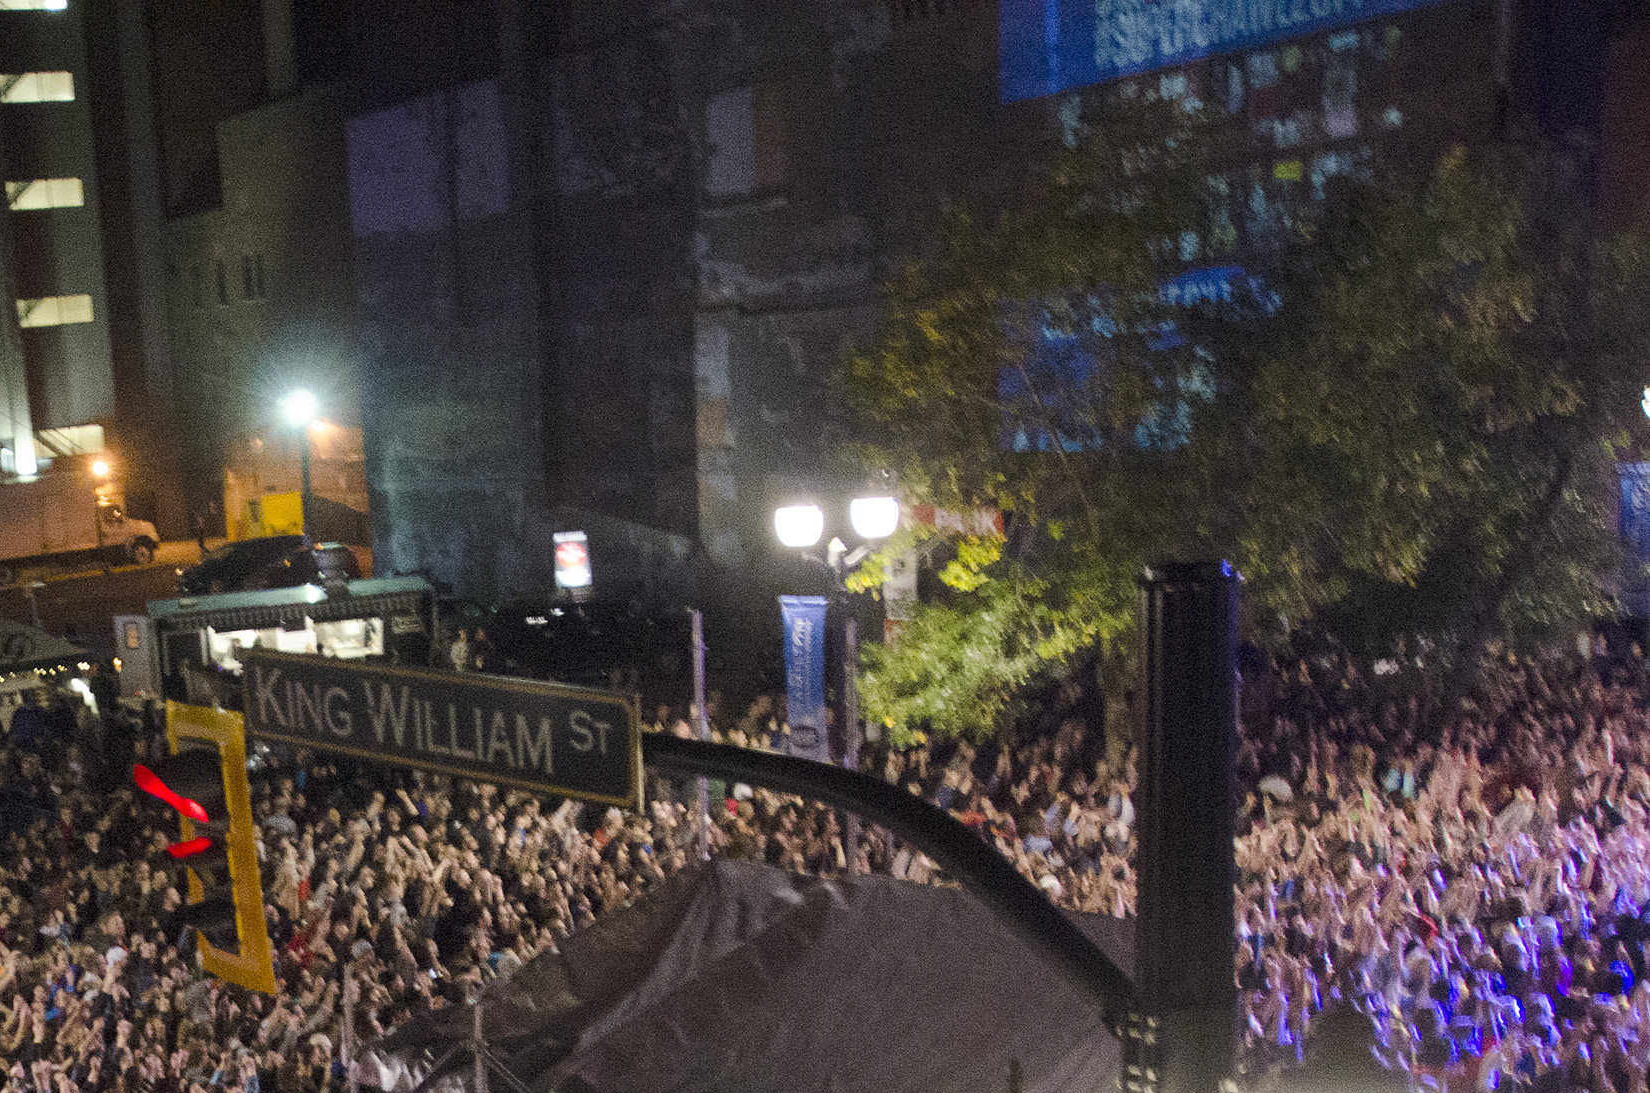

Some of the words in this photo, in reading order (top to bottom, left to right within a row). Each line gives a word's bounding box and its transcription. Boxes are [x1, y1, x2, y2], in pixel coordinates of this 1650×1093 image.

[254, 666, 351, 737] KING
[363, 680, 553, 775] WILLIAM
[569, 709, 612, 756] ST
